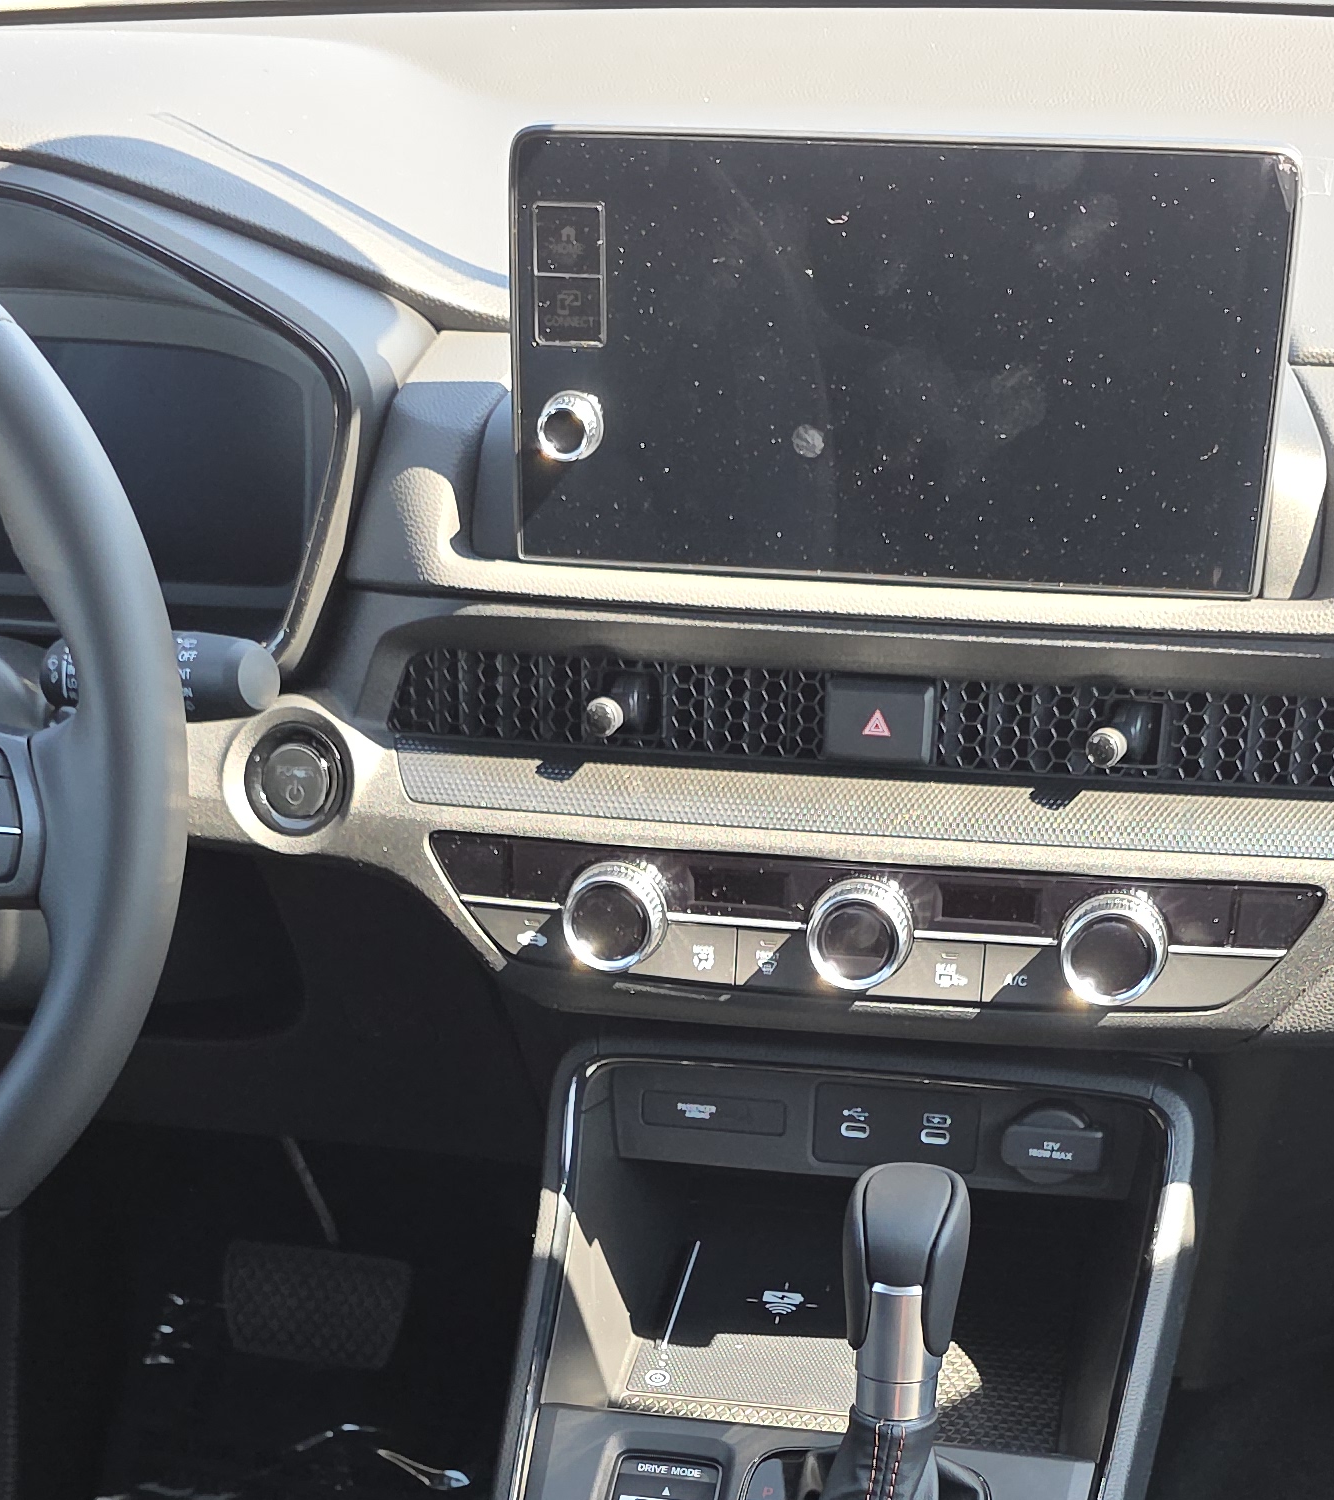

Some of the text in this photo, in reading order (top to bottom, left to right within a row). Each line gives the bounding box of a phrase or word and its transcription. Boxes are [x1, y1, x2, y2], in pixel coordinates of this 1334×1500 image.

[544, 315, 594, 328] CONNECT
[1002, 973, 1027, 987] A/C
[637, 1463, 702, 1478] DRIVE MODE
[762, 1486, 774, 1498] P
